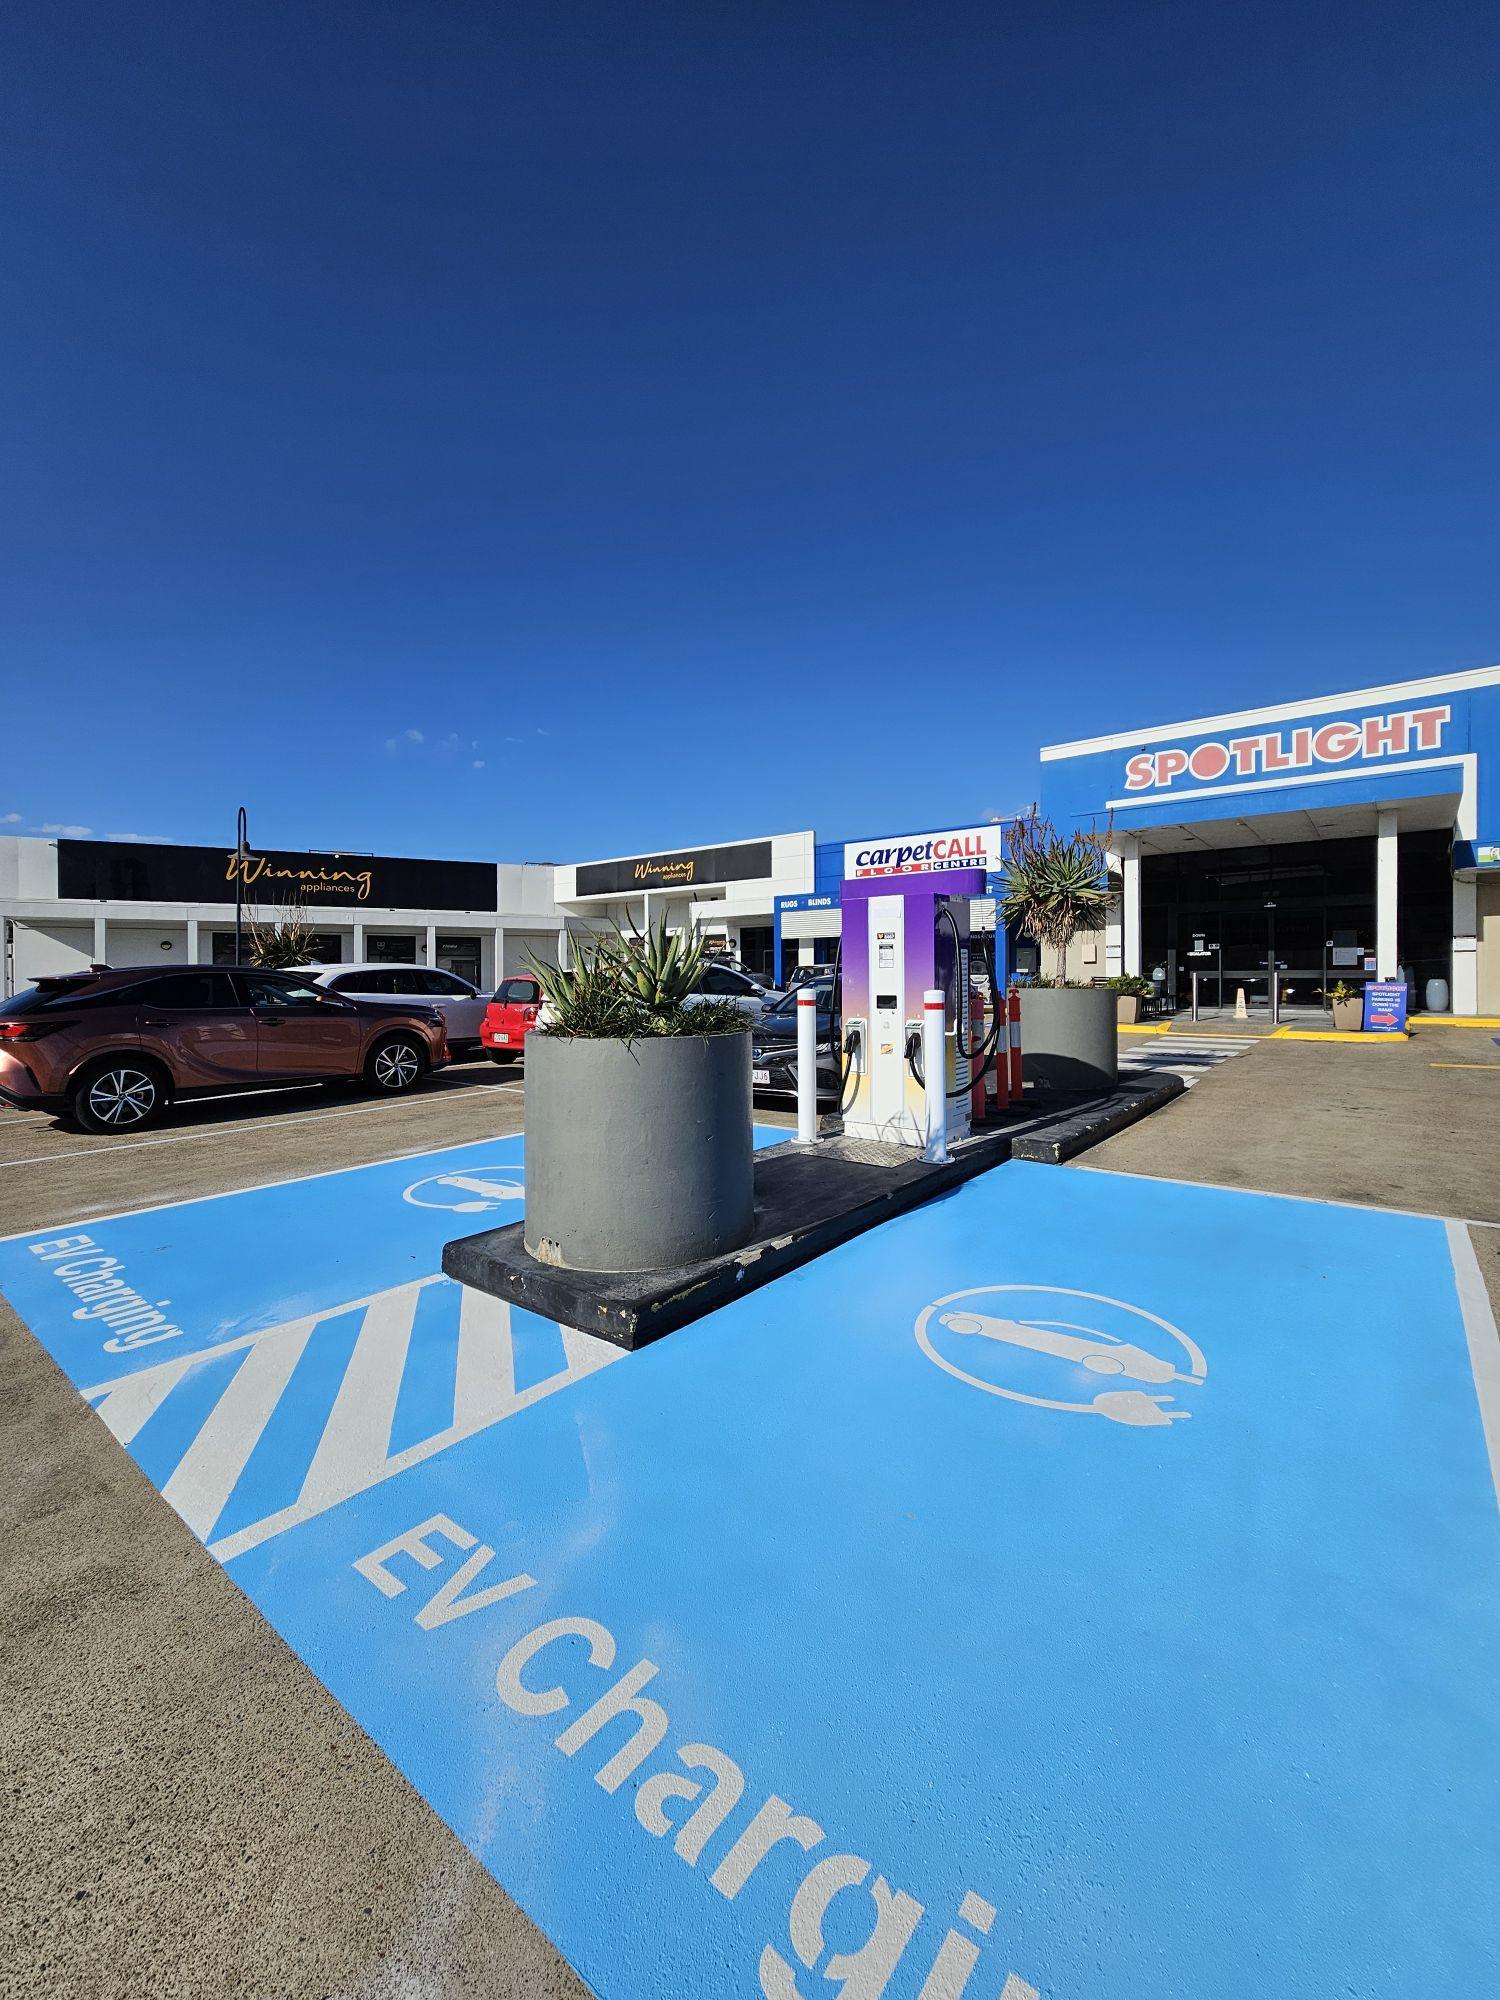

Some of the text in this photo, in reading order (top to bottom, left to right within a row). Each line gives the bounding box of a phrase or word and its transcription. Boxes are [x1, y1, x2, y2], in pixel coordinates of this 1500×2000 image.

[1124, 705, 1451, 790] SPOTLIGHT
[634, 860, 694, 881] Winning
[662, 872, 687, 880] appliances
[857, 857, 986, 877] FLOOR CENTRE
[225, 857, 373, 900] Winning
[300, 882, 355, 893] appliances
[780, 897, 831, 909] RUGS BLINDS
[28, 1234, 184, 1353] EV Charging
[351, 1512, 1041, 2000] EV Chargi
